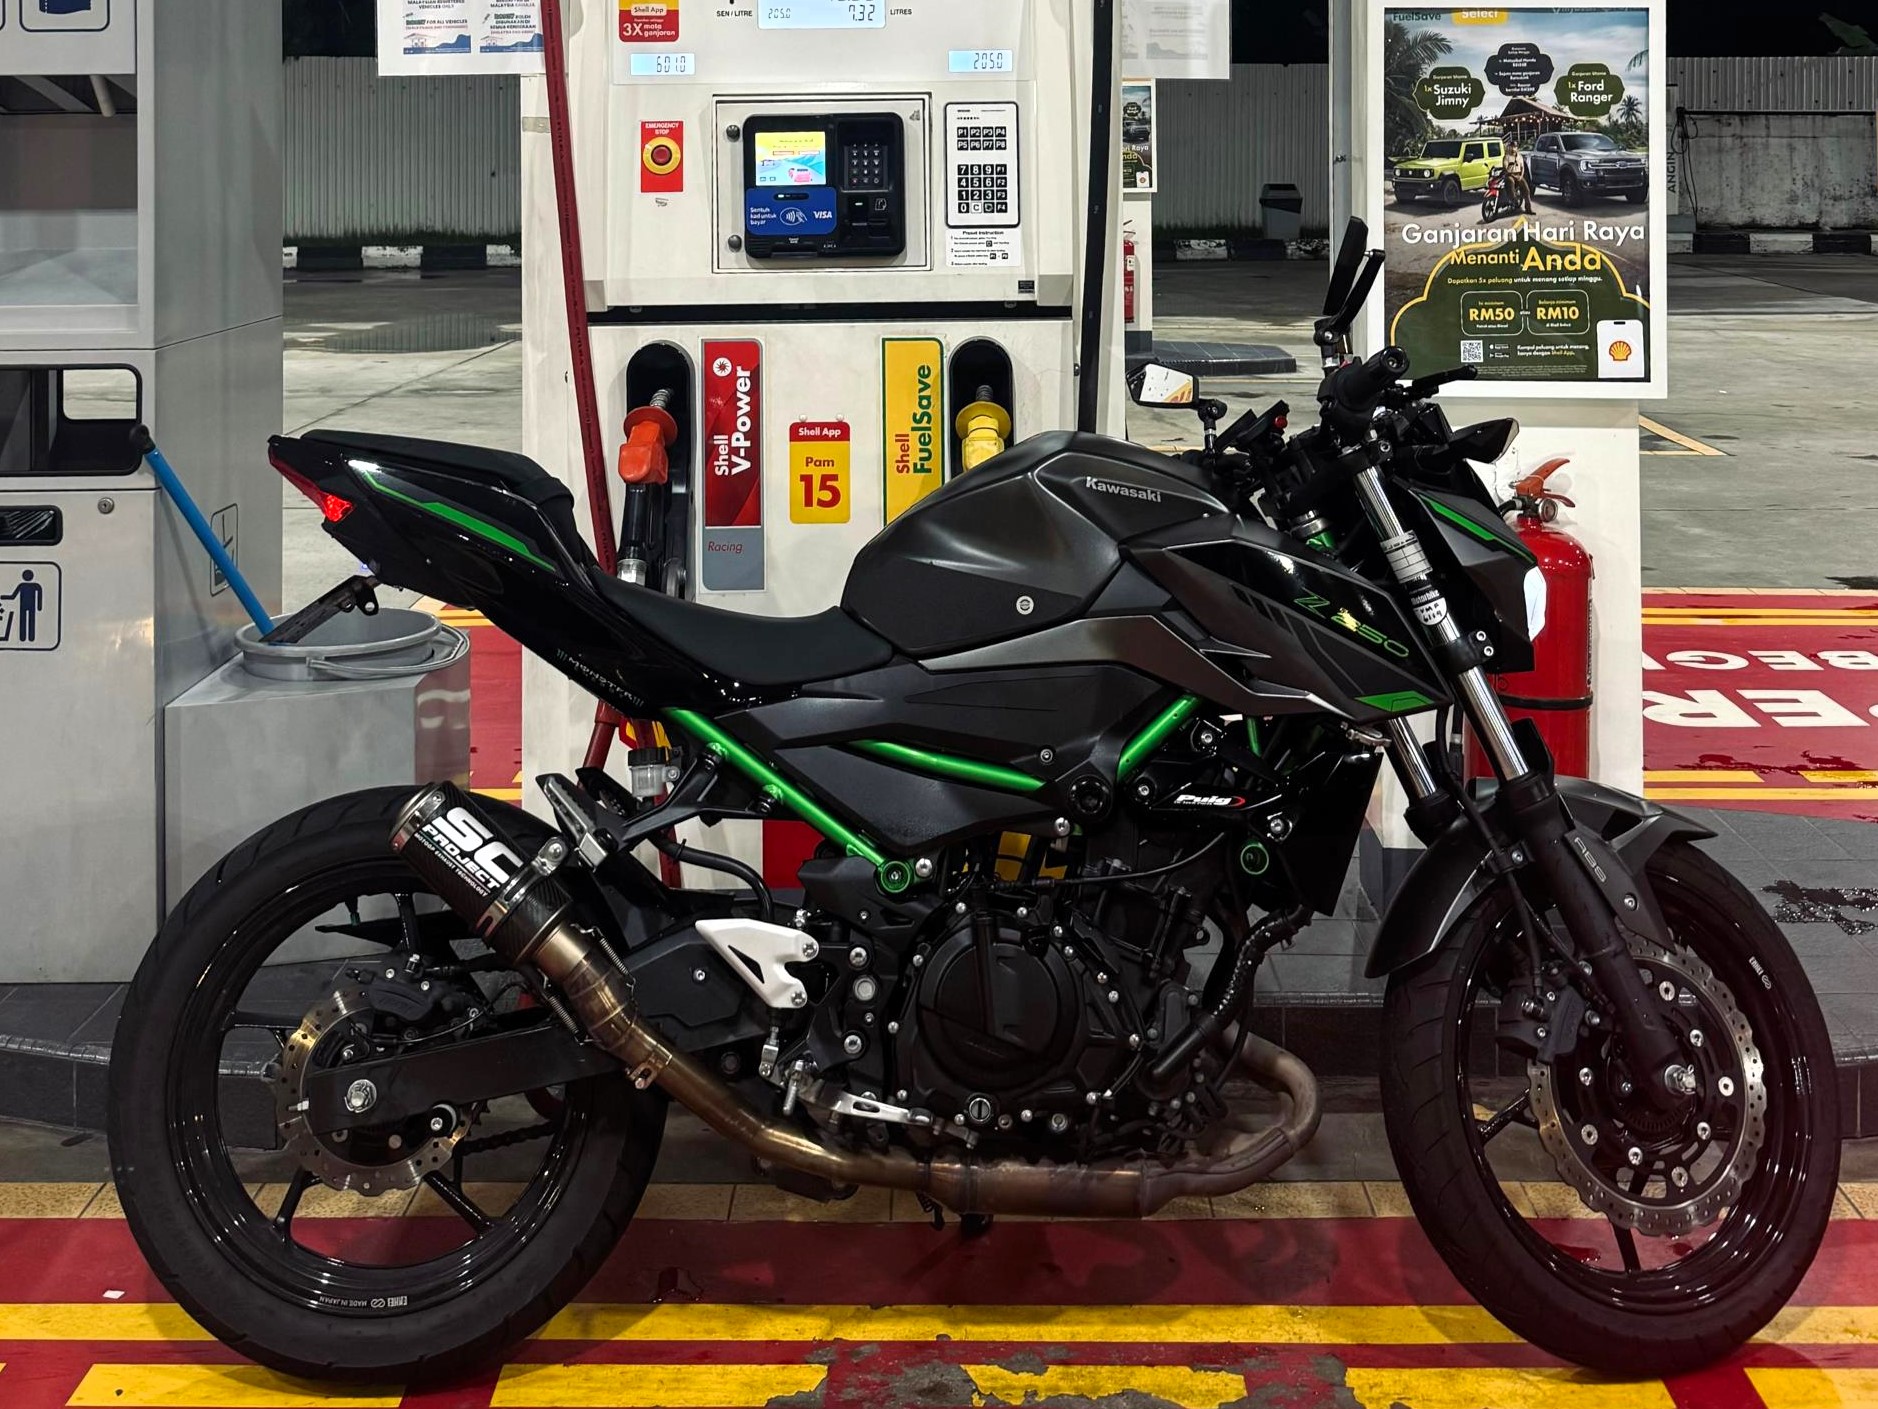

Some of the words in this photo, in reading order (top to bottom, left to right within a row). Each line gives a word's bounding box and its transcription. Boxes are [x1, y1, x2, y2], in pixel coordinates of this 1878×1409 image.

[634, 5, 650, 13] Shell
[650, 5, 664, 13] App
[848, 4, 876, 22] 7.32
[889, 8, 913, 16] LITRES
[1461, 9, 1499, 19] Select
[1392, 10, 1441, 22] FuelSave
[623, 23, 643, 36] 3X
[1433, 82, 1472, 95] Suzuki
[1577, 79, 1604, 91] Ford
[1435, 94, 1470, 108] Jimny
[1570, 92, 1613, 105] Ranger
[958, 128, 967, 136] P1
[970, 128, 980, 136] P2
[995, 128, 1006, 136] P4
[958, 141, 968, 149] P5
[970, 141, 980, 149] P6
[1131, 145, 1149, 153] Raya
[960, 166, 966, 174] 7
[972, 166, 979, 174] 8
[985, 165, 992, 174] 9
[1666, 151, 1676, 193] ANGIN
[960, 178, 966, 187] 4
[973, 178, 979, 187] 5
[985, 178, 992, 187] 6
[961, 191, 966, 199] 1
[973, 191, 980, 199] 2
[985, 190, 992, 199] 3
[960, 203, 967, 212] 0
[972, 203, 980, 211] C
[812, 211, 833, 219] VISA
[1401, 222, 1517, 249] Ganjaran
[1522, 220, 1576, 242] Hari
[1583, 220, 1646, 248] Raya
[1450, 249, 1520, 265] Menanti
[1522, 245, 1601, 271] Anda
[1447, 277, 1478, 285] Dapatkan
[1488, 277, 1513, 285] peluang
[1532, 276, 1557, 284] menang
[1558, 275, 1577, 283] setiap
[1469, 307, 1515, 321] RM50
[1536, 306, 1580, 320] RM10
[731, 365, 752, 476] V-Power
[911, 364, 932, 474] FuelSave
[798, 427, 820, 437] Shell
[822, 427, 841, 439] App
[714, 434, 729, 477] Shell
[895, 433, 910, 474] Shell
[805, 456, 835, 468] Pam
[799, 473, 842, 509] 15
[1085, 475, 1162, 503] Kawasaki
[708, 541, 743, 555] Racing
[1176, 794, 1232, 806] Puig
[431, 806, 524, 885] SC
[421, 823, 501, 889] PROJECT
[1574, 836, 1607, 883] ABS
